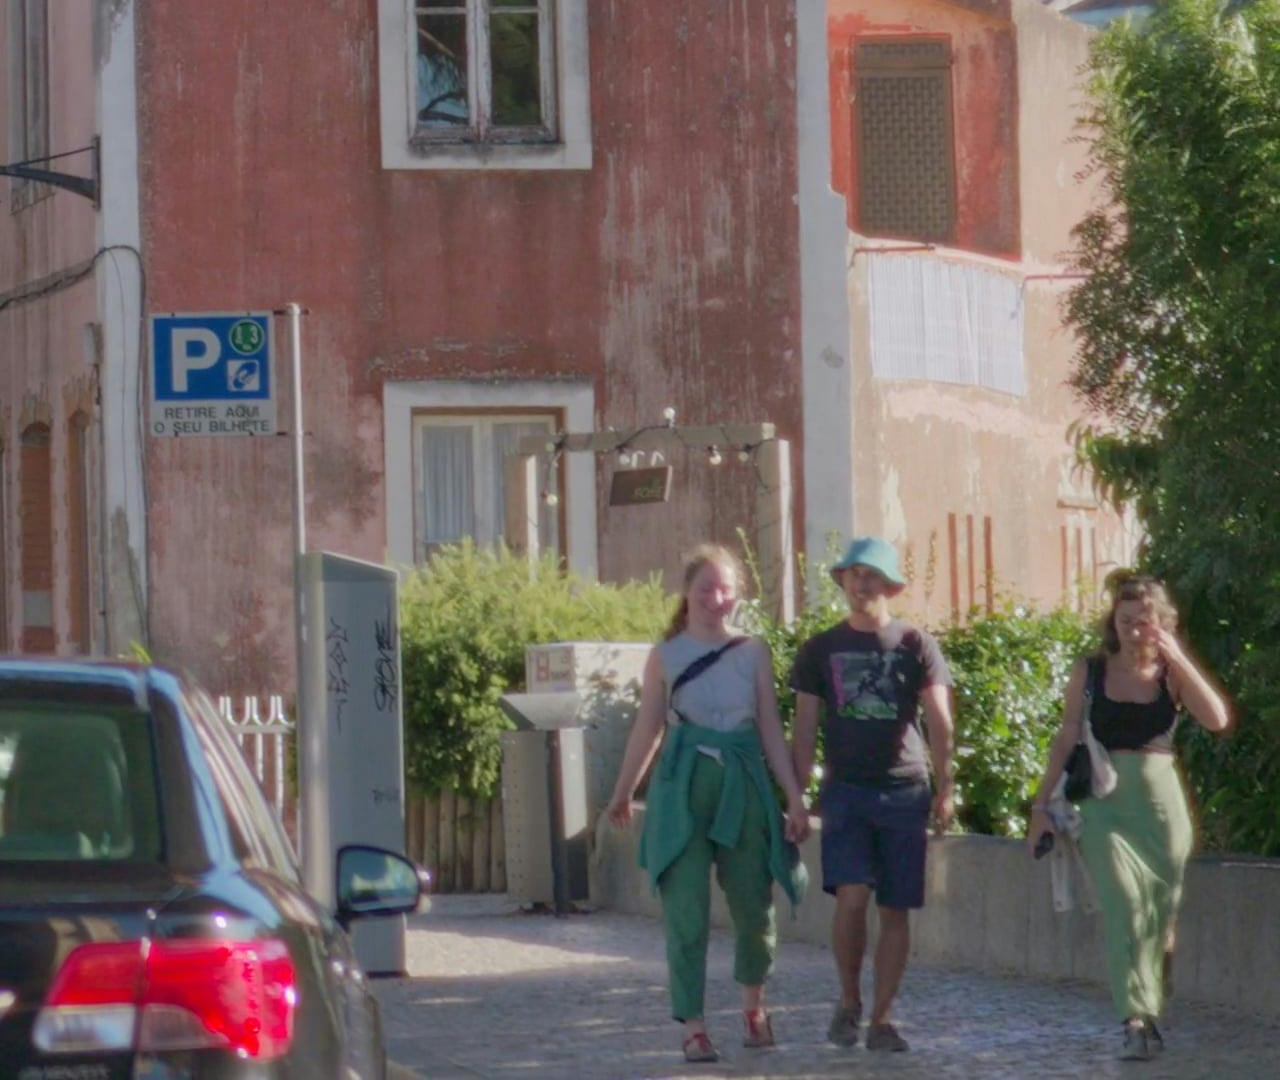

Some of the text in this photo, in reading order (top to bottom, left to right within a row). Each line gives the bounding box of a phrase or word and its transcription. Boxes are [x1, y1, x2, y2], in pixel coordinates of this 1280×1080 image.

[171, 328, 222, 393] P
[164, 406, 260, 418] RETIRE AQUI
[154, 420, 270, 433] O SEU BILHETE
